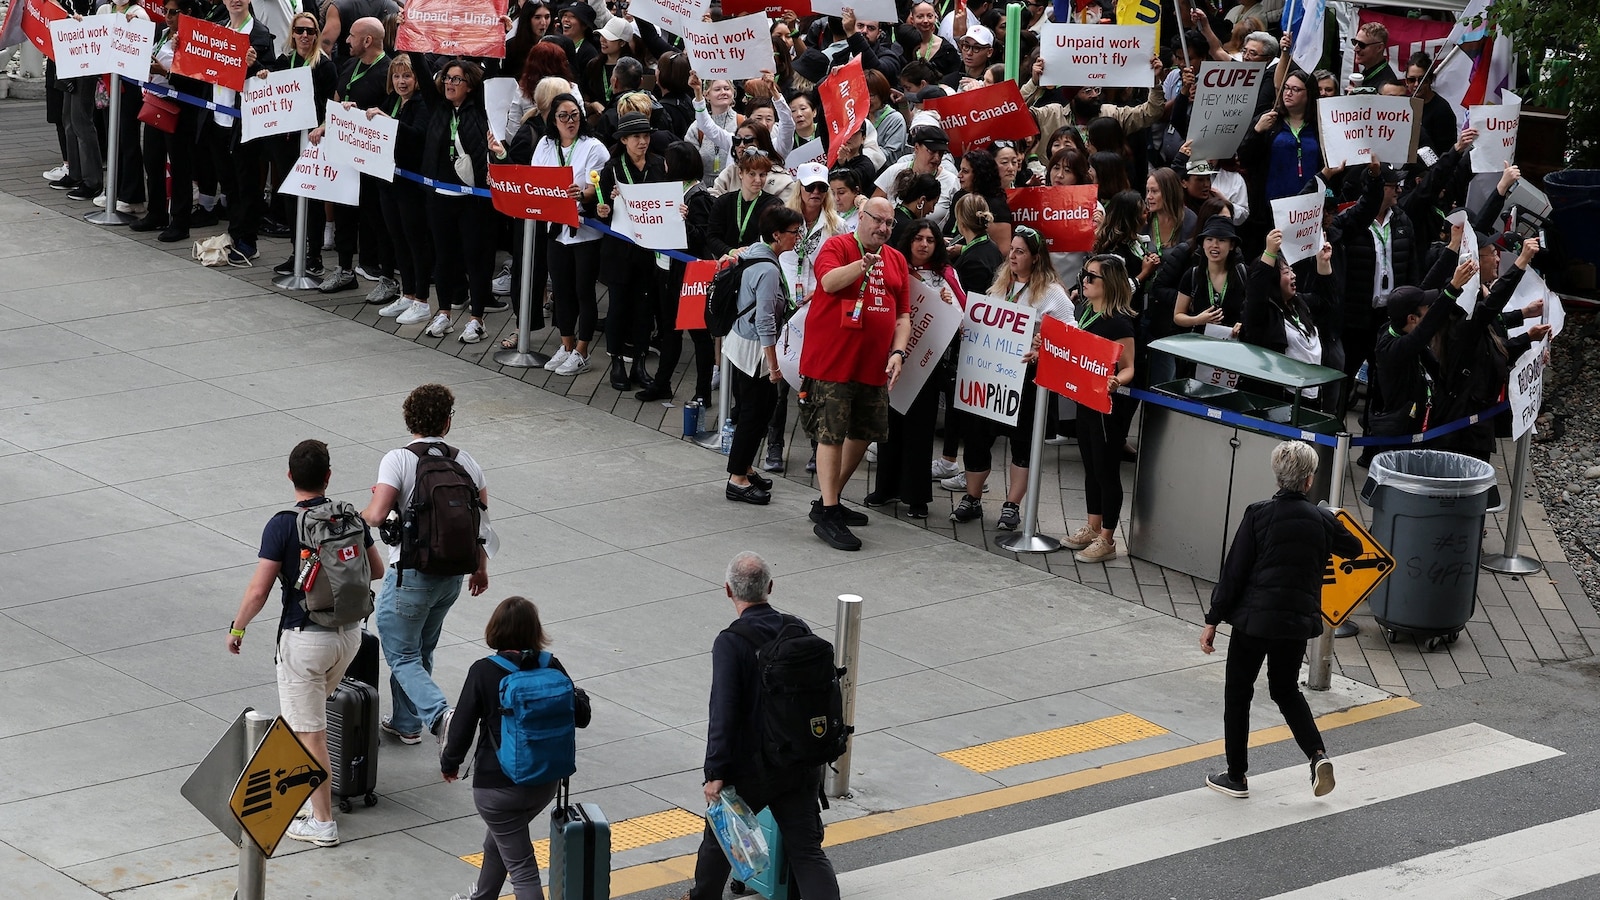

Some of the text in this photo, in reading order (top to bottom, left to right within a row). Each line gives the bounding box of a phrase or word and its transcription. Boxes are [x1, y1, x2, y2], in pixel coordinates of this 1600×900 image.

[407, 8, 448, 23] Unpaid
[464, 12, 500, 26] Unfair
[57, 26, 108, 43] Unpaid work
[125, 31, 141, 43] wages
[192, 30, 208, 44] Non
[210, 38, 228, 51] payé
[683, 26, 756, 45] Unpaid work
[1056, 35, 1140, 50] Unpaid work
[69, 42, 101, 56] won't fly
[185, 42, 241, 67] Aucun respect
[693, 47, 745, 61] won't fly
[1072, 53, 1127, 67] won't fly
[1203, 69, 1260, 87] CUPE
[244, 80, 300, 102] Unpaid work
[838, 80, 850, 98] Air
[251, 98, 293, 116] won't fly
[1201, 93, 1248, 106] HEY MIKE
[940, 101, 1018, 130] nfAir Canada
[1204, 108, 1243, 120] U WORK
[1331, 108, 1410, 125] Unpaid work
[331, 114, 357, 133] Poverty
[358, 124, 381, 140] wages
[1200, 123, 1238, 138] 4 FREE!
[1344, 125, 1395, 141] won't fly
[338, 130, 382, 154] UnCanadian
[974, 136, 991, 145] CUPE
[301, 146, 319, 160] paid
[295, 164, 338, 182] won't fly
[301, 183, 317, 191] CUPE
[490, 180, 568, 198] UnfAir Canada
[628, 200, 661, 212] wages
[1011, 206, 1089, 221] nfAir Canada
[1289, 204, 1321, 224] Unpaid
[682, 282, 709, 296] UnfAi
[969, 302, 1030, 335] CUPE
[962, 328, 1024, 357] FLY A MILE
[919, 348, 934, 368] CUPE
[966, 354, 974, 365] in
[977, 357, 992, 370] our
[1044, 338, 1070, 361] Unpaid
[1080, 355, 1108, 376] Unfair
[1065, 382, 1078, 393] CUPE
